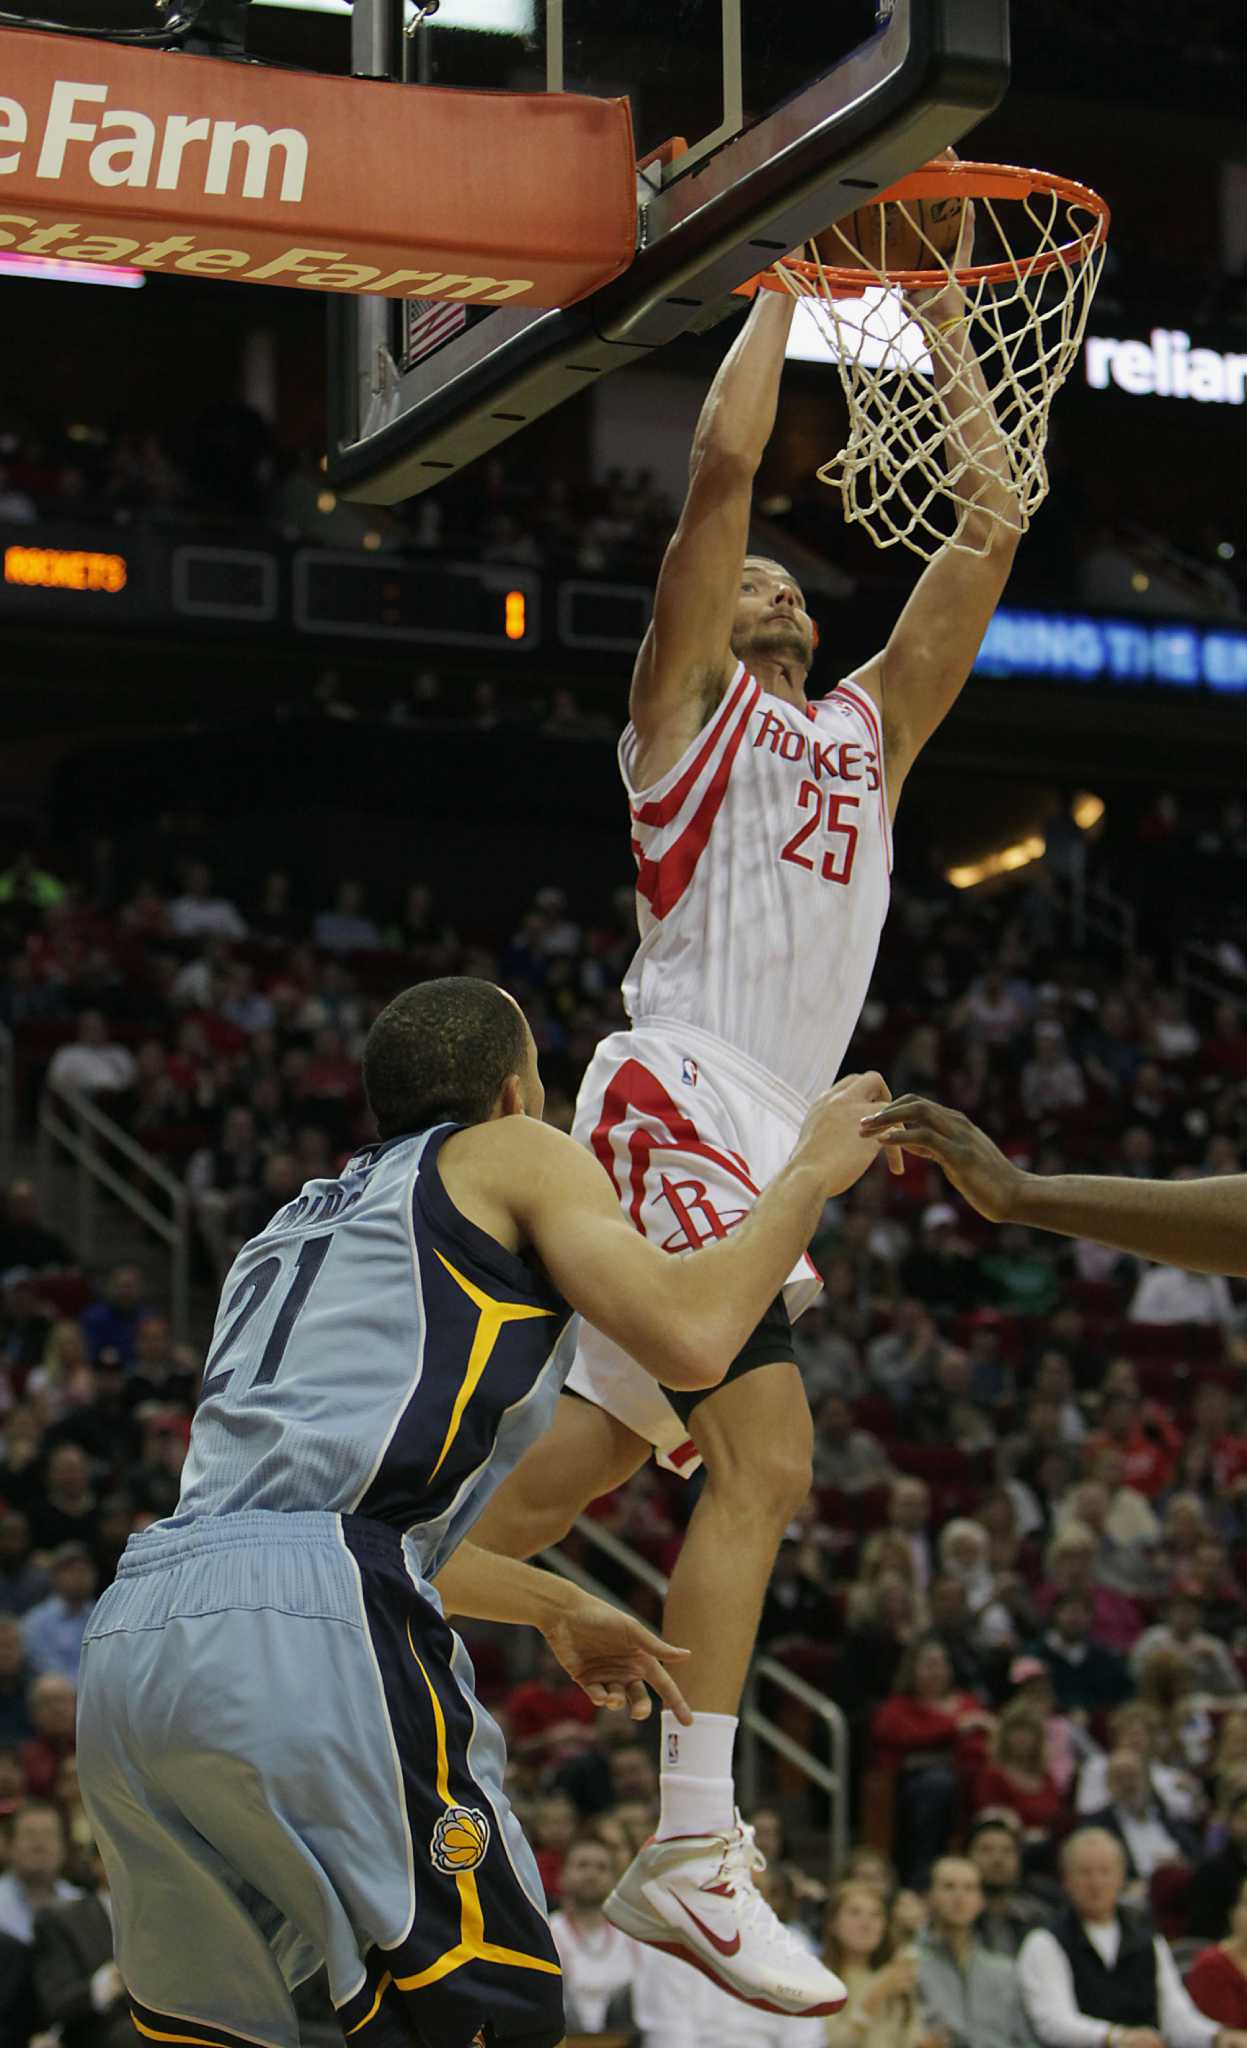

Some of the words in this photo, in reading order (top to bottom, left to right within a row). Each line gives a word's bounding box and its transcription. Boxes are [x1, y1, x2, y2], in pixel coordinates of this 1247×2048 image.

[241, 248, 534, 300] Farm
[780, 779, 860, 886] 25
[201, 1232, 335, 1398] 21
